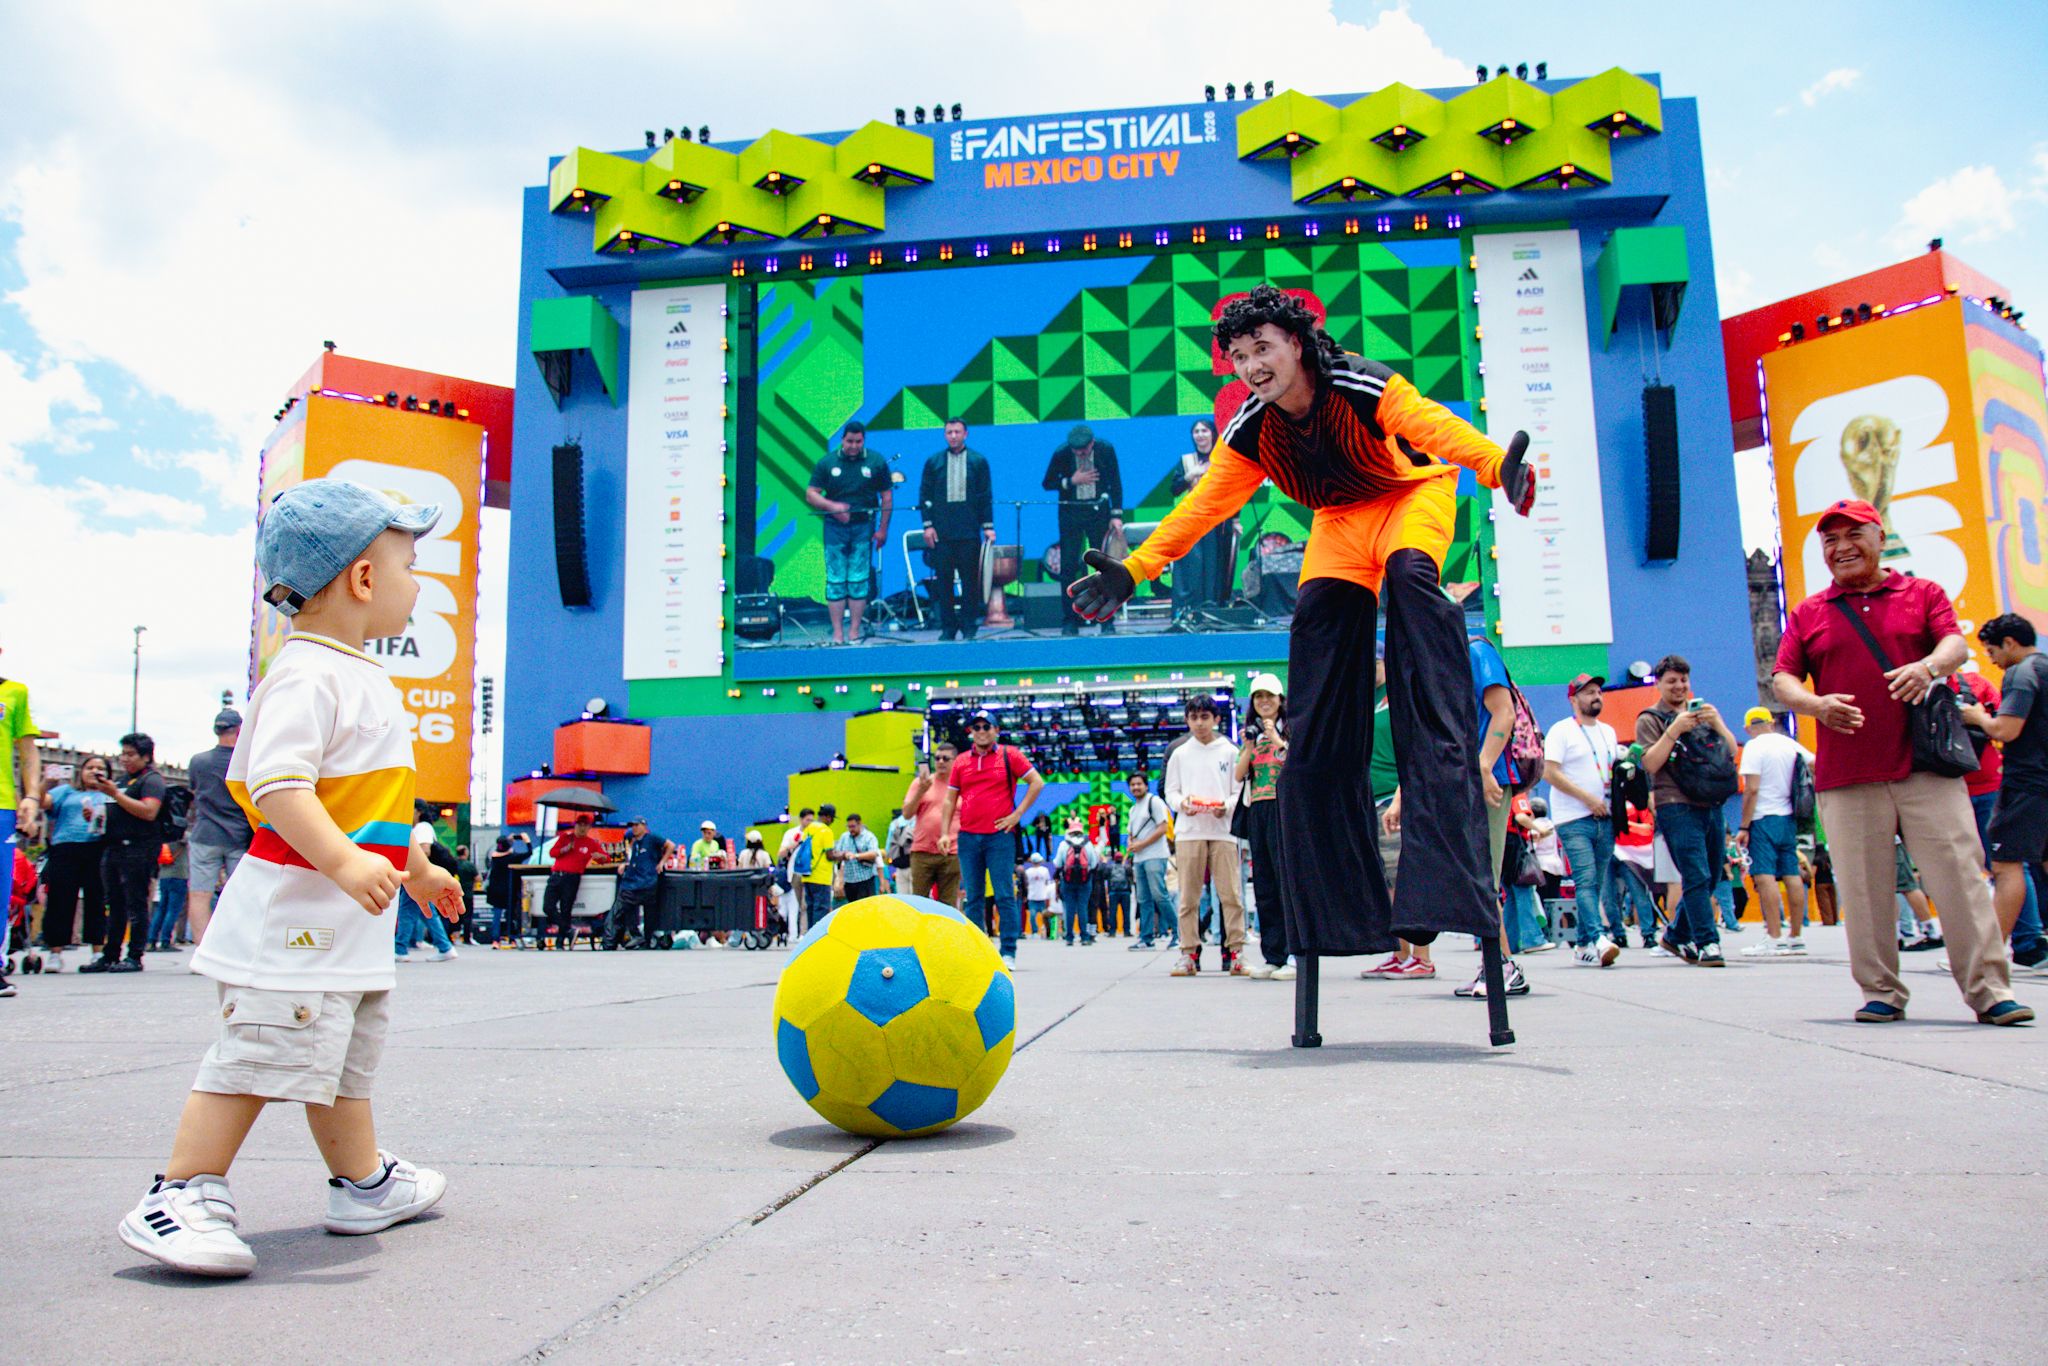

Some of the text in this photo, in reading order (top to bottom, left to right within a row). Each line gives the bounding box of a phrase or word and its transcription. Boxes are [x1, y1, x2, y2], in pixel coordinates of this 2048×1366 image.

[1205, 110, 1217, 142] 2026
[950, 130, 964, 161] FIFA
[984, 150, 1180, 189] MEXICO CITY
[1526, 382, 1552, 392] VISA
[665, 429, 689, 439] VISA
[408, 688, 456, 710] CUP
